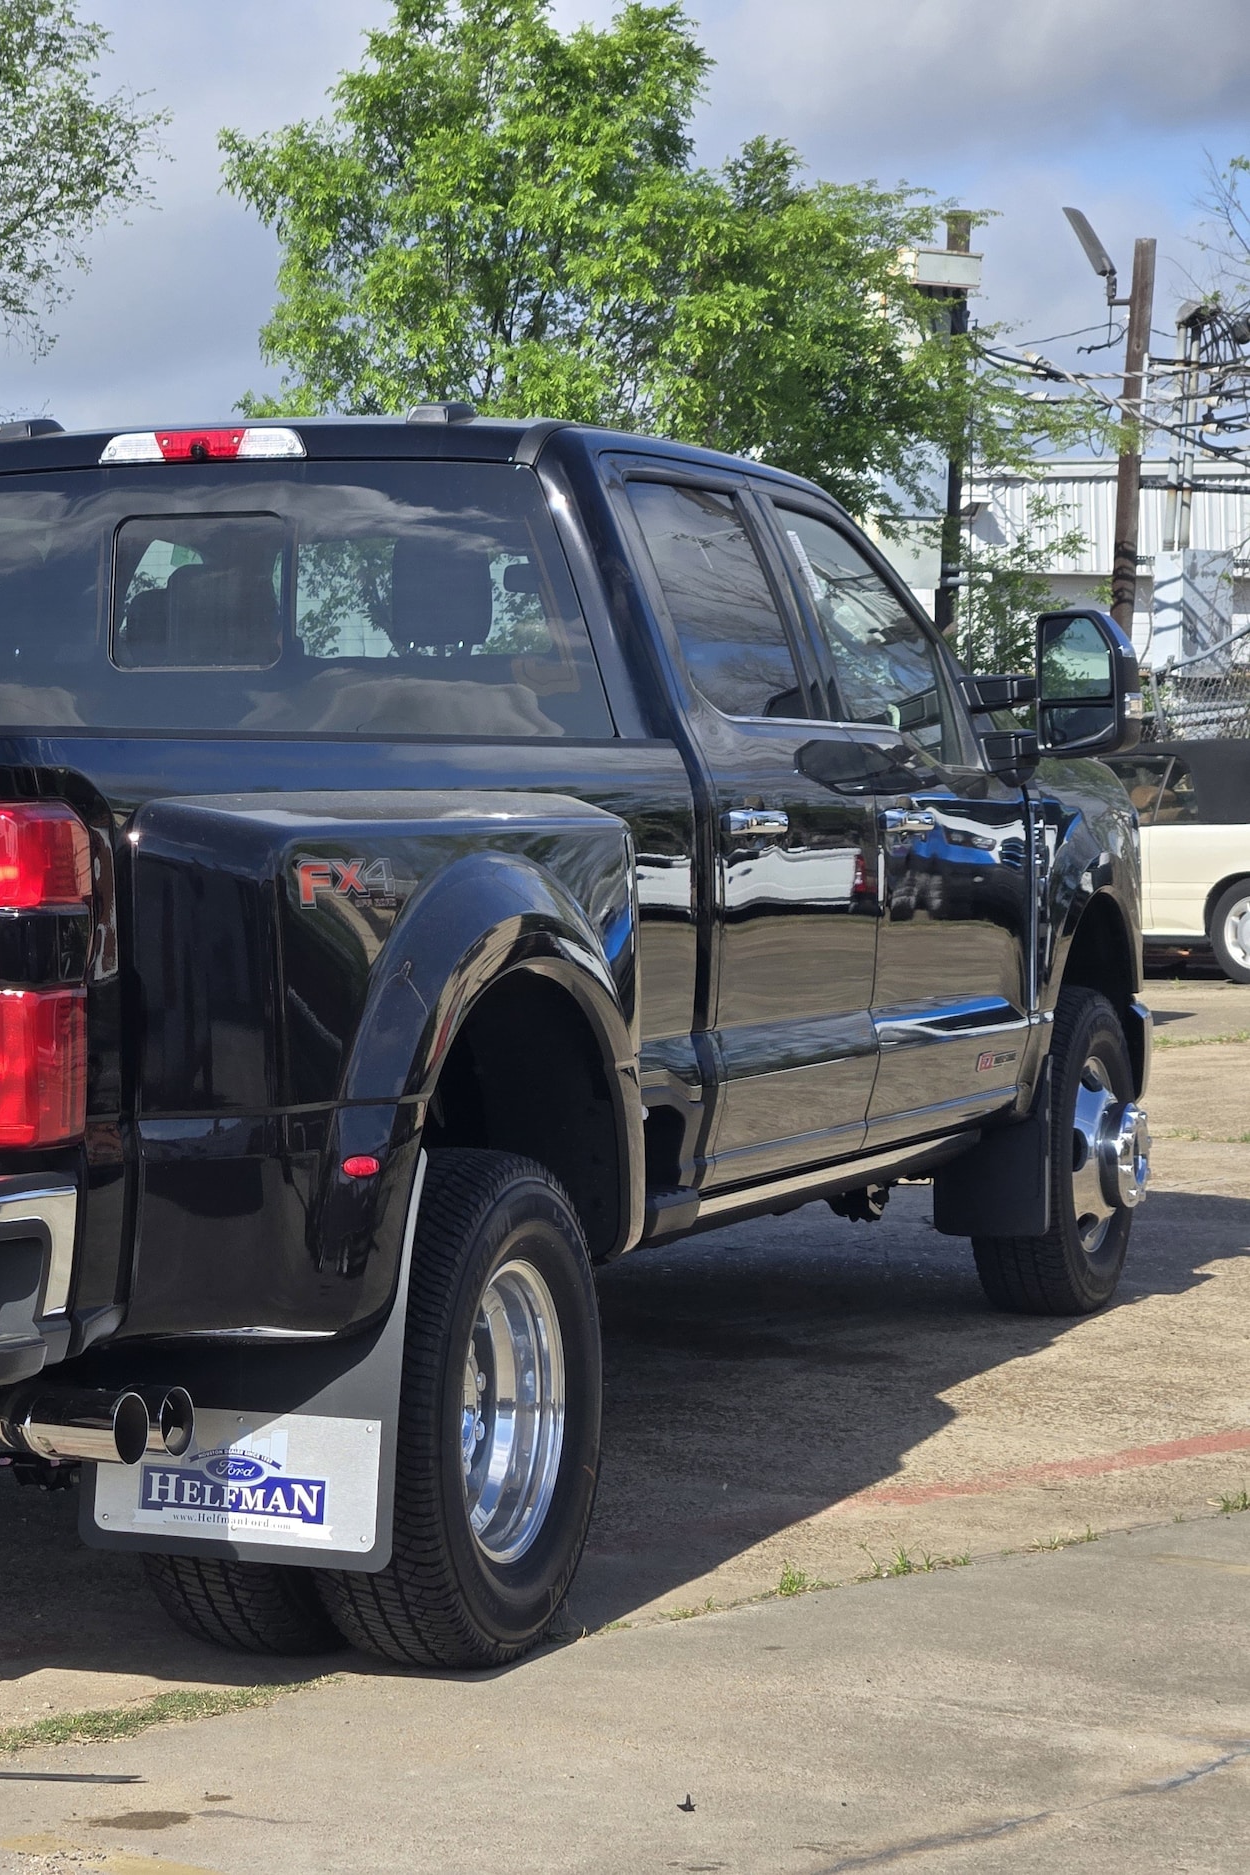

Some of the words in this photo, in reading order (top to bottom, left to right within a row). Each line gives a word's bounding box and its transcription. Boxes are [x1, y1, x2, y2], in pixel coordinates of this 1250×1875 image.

[298, 858, 396, 909] FX4
[215, 1460, 256, 1478] Ford
[147, 1472, 322, 1516] HELFMAN
[172, 1513, 291, 1530] www.HelfmanFord.com
